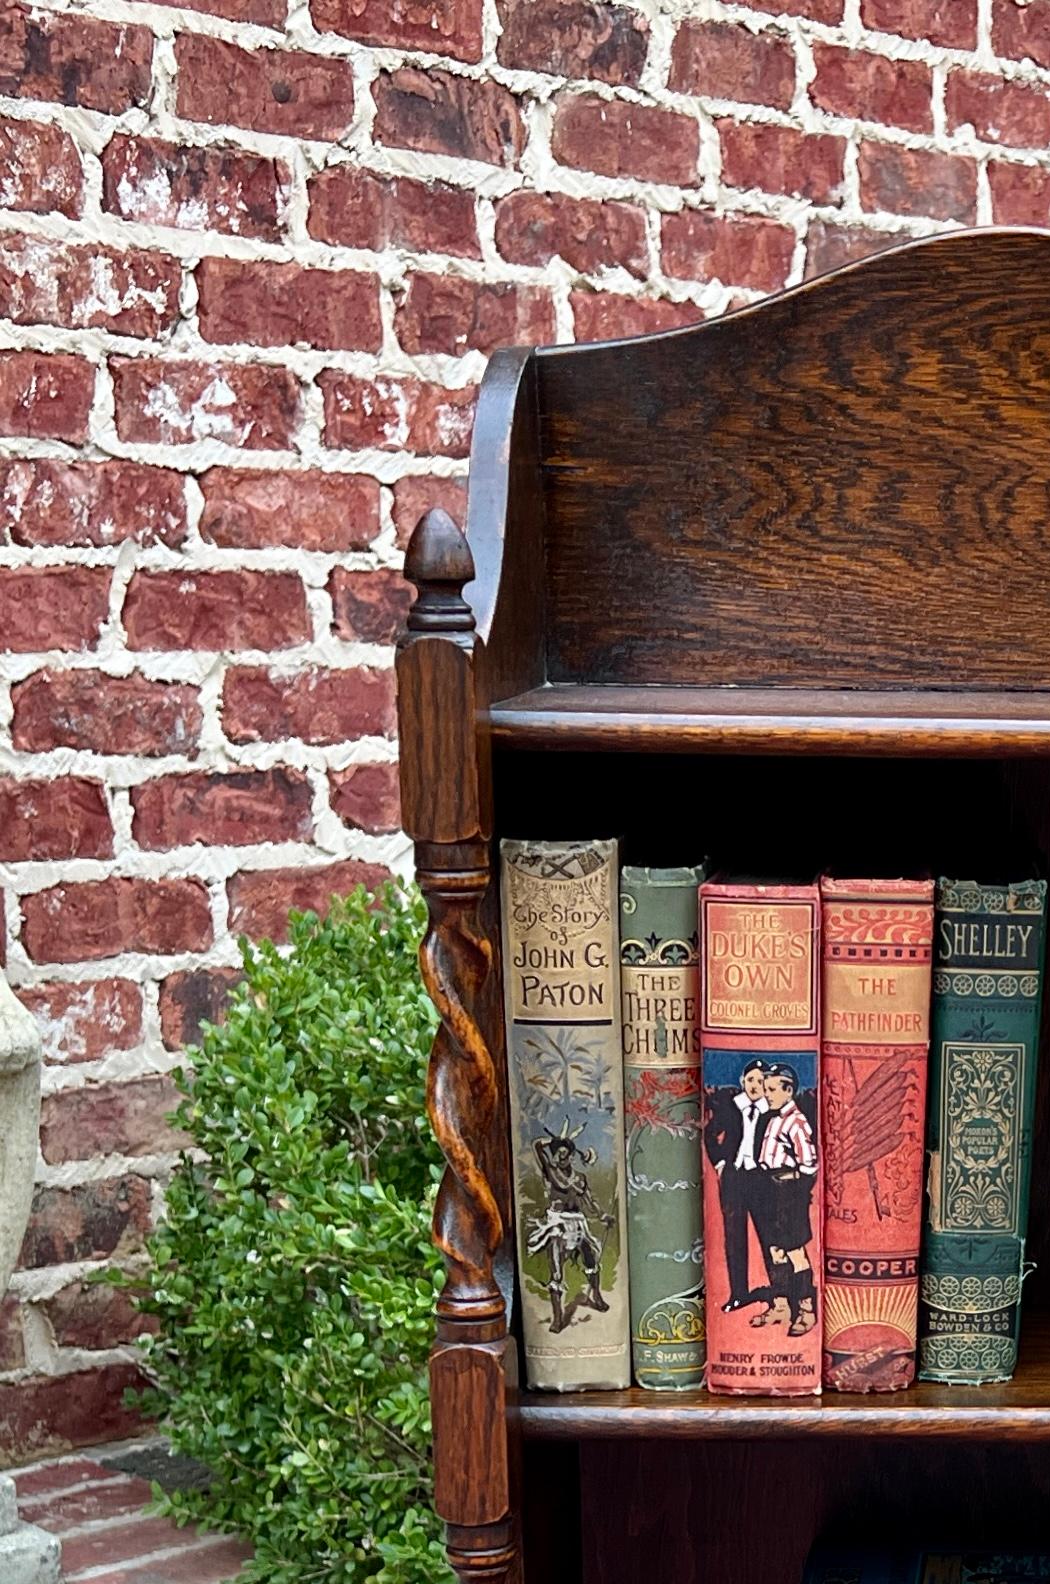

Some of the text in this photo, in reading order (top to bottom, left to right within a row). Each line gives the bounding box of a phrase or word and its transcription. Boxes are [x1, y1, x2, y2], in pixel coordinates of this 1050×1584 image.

[512, 903, 605, 931] The Story
[739, 913, 780, 929] THE
[550, 926, 568, 946] of
[712, 931, 806, 959] DUKE'S
[939, 919, 1033, 960] SHELLEY
[513, 941, 609, 968] JOHN G.
[637, 973, 681, 991] THE
[724, 963, 793, 989] OWN
[521, 975, 604, 1008] PATON
[858, 978, 897, 996] THE
[624, 991, 696, 1022] THREE
[710, 1002, 809, 1018] COLONEL GROVES
[831, 1012, 923, 1033] PATHFINDER
[961, 1136, 998, 1145] POPULAR
[827, 1259, 916, 1277] COOPER
[929, 1322, 980, 1333] BOWDEN
[983, 1323, 992, 1332] &
[656, 1351, 689, 1364] SHAW
[720, 1352, 804, 1364] HENRY FROWDE
[835, 1346, 886, 1382] HURST
[711, 1364, 815, 1376] HODDER & STOUGHTON
